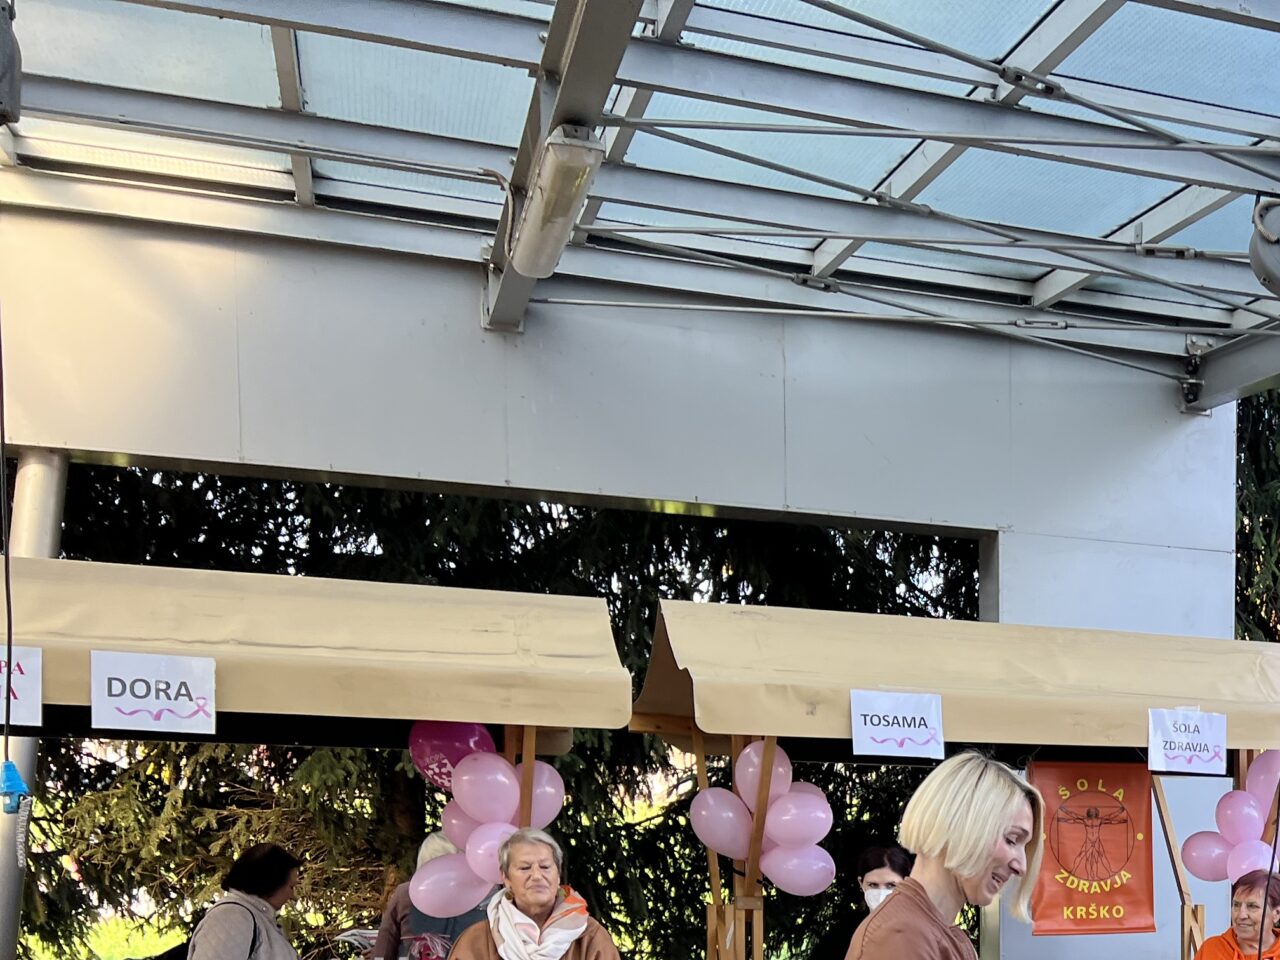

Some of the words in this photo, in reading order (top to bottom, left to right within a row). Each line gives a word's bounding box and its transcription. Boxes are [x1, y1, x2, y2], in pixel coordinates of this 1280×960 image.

[107, 677, 193, 702] DORA
[860, 714, 928, 728] TOSAMA
[1172, 720, 1200, 735] ŠOLA
[1163, 740, 1209, 753] ZDRAVJA
[1058, 779, 1125, 801] ŠOLA
[1055, 869, 1132, 894] ZDRAVJA
[1063, 904, 1124, 920] KRŠKO
